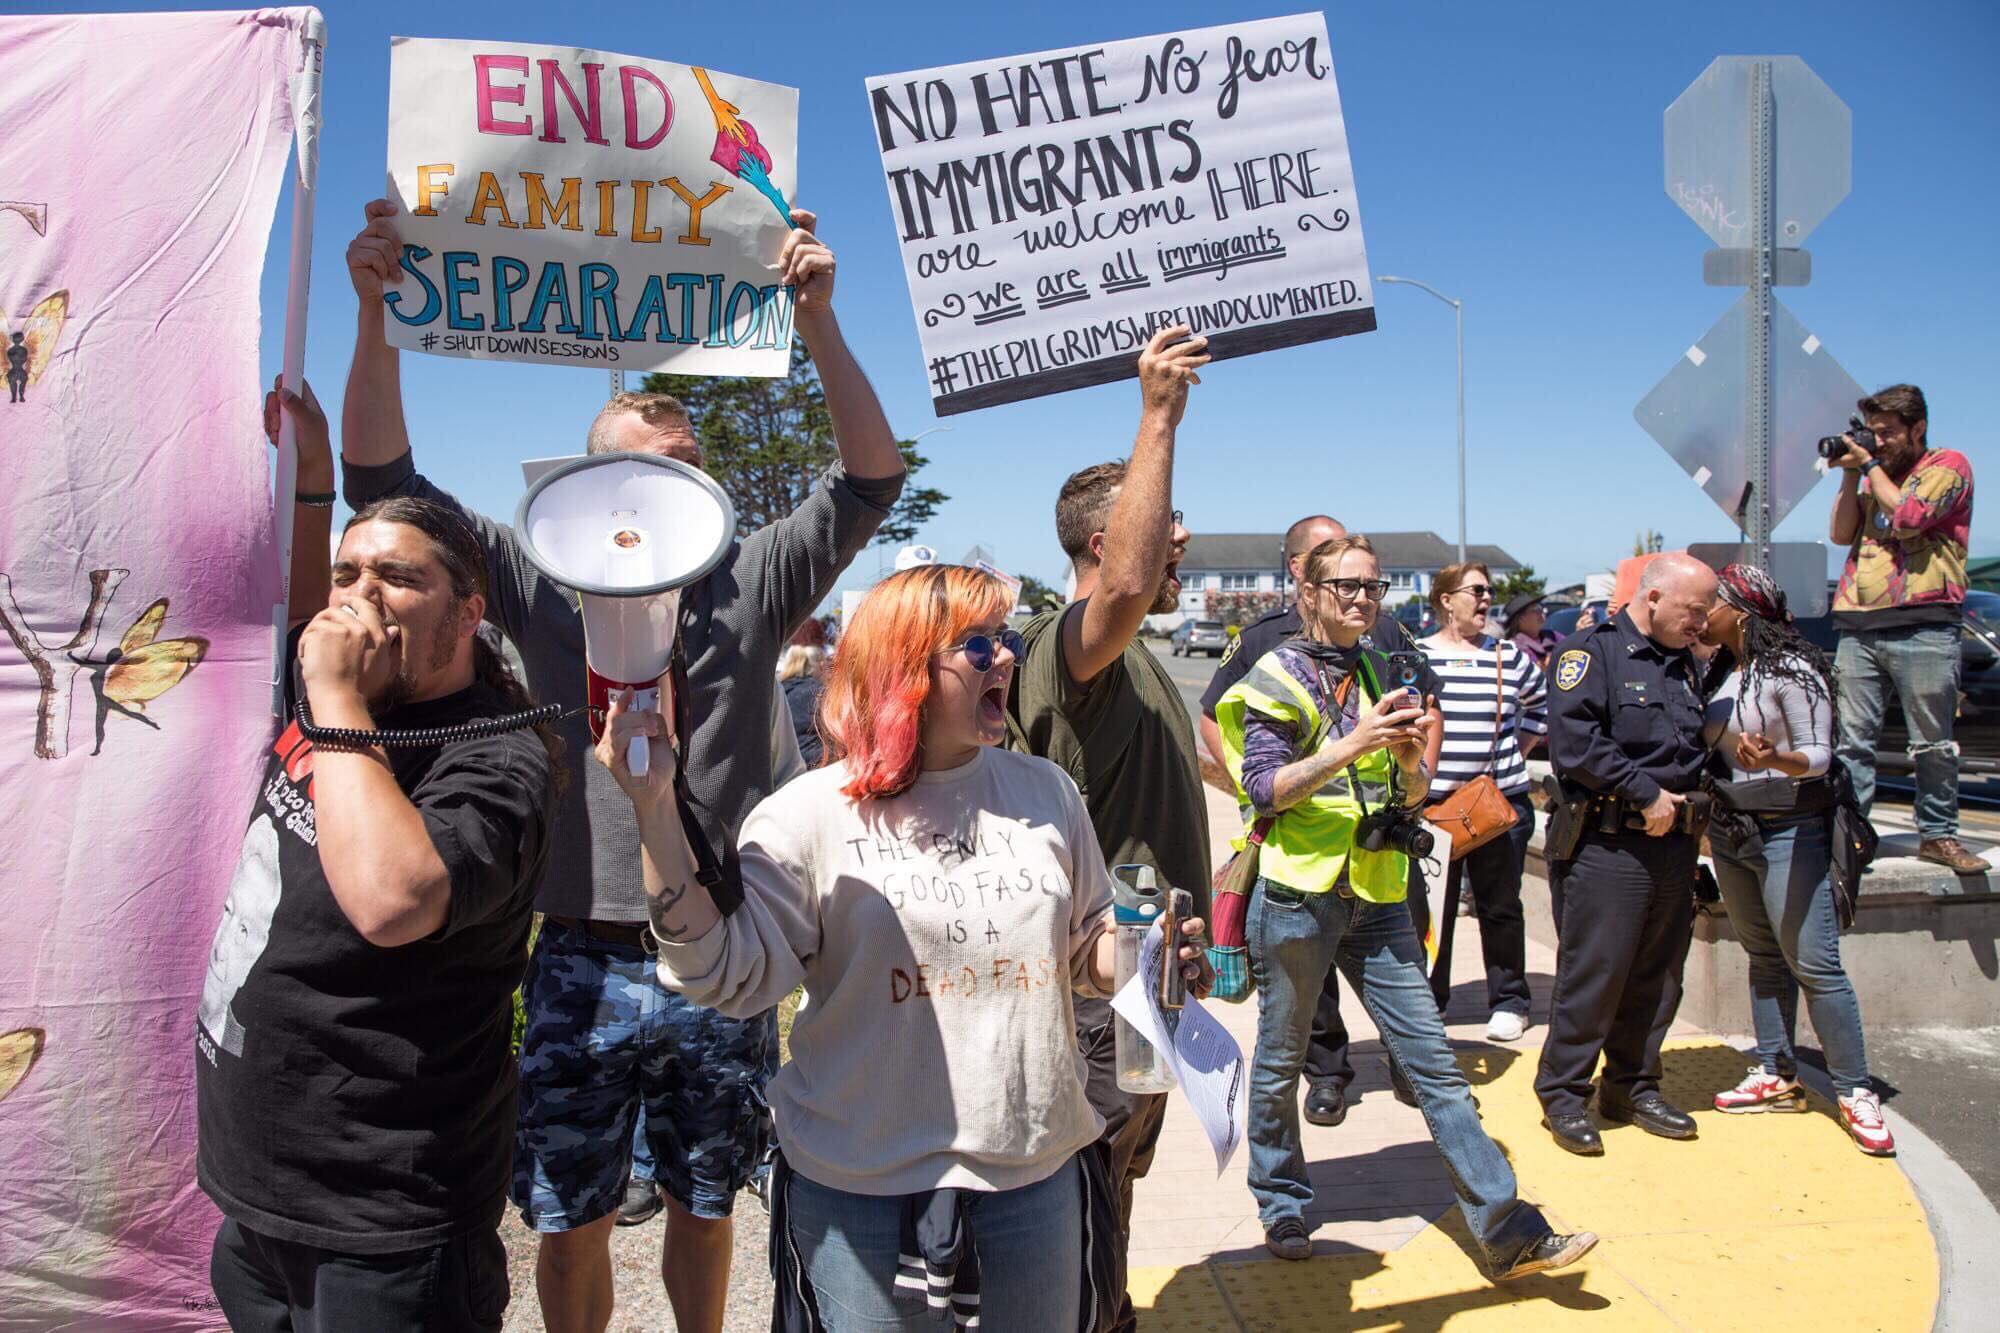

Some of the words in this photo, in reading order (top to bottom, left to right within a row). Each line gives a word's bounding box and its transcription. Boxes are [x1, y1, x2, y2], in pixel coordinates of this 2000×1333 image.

[473, 54, 675, 150] END
[870, 77, 958, 153] NO
[970, 48, 1128, 138] HATE.
[1135, 37, 1208, 105] No
[1217, 36, 1330, 119] fear.
[414, 163, 734, 247] FAMILY
[887, 119, 1202, 244] IMMIGRANTS
[917, 241, 997, 279] are
[1014, 195, 1195, 254] welcome
[1206, 148, 1339, 221] HERE.
[384, 244, 797, 351] SEPARATION
[968, 281, 1022, 312] we
[1037, 268, 1088, 298] are
[1101, 248, 1143, 284] all
[1157, 225, 1282, 281] immigrants
[846, 837, 914, 868] THE
[932, 831, 1016, 863] ONLY
[883, 873, 966, 910] GOOD
[946, 919, 968, 945] IS
[984, 919, 1001, 945] A
[890, 963, 977, 1004] DEAD
